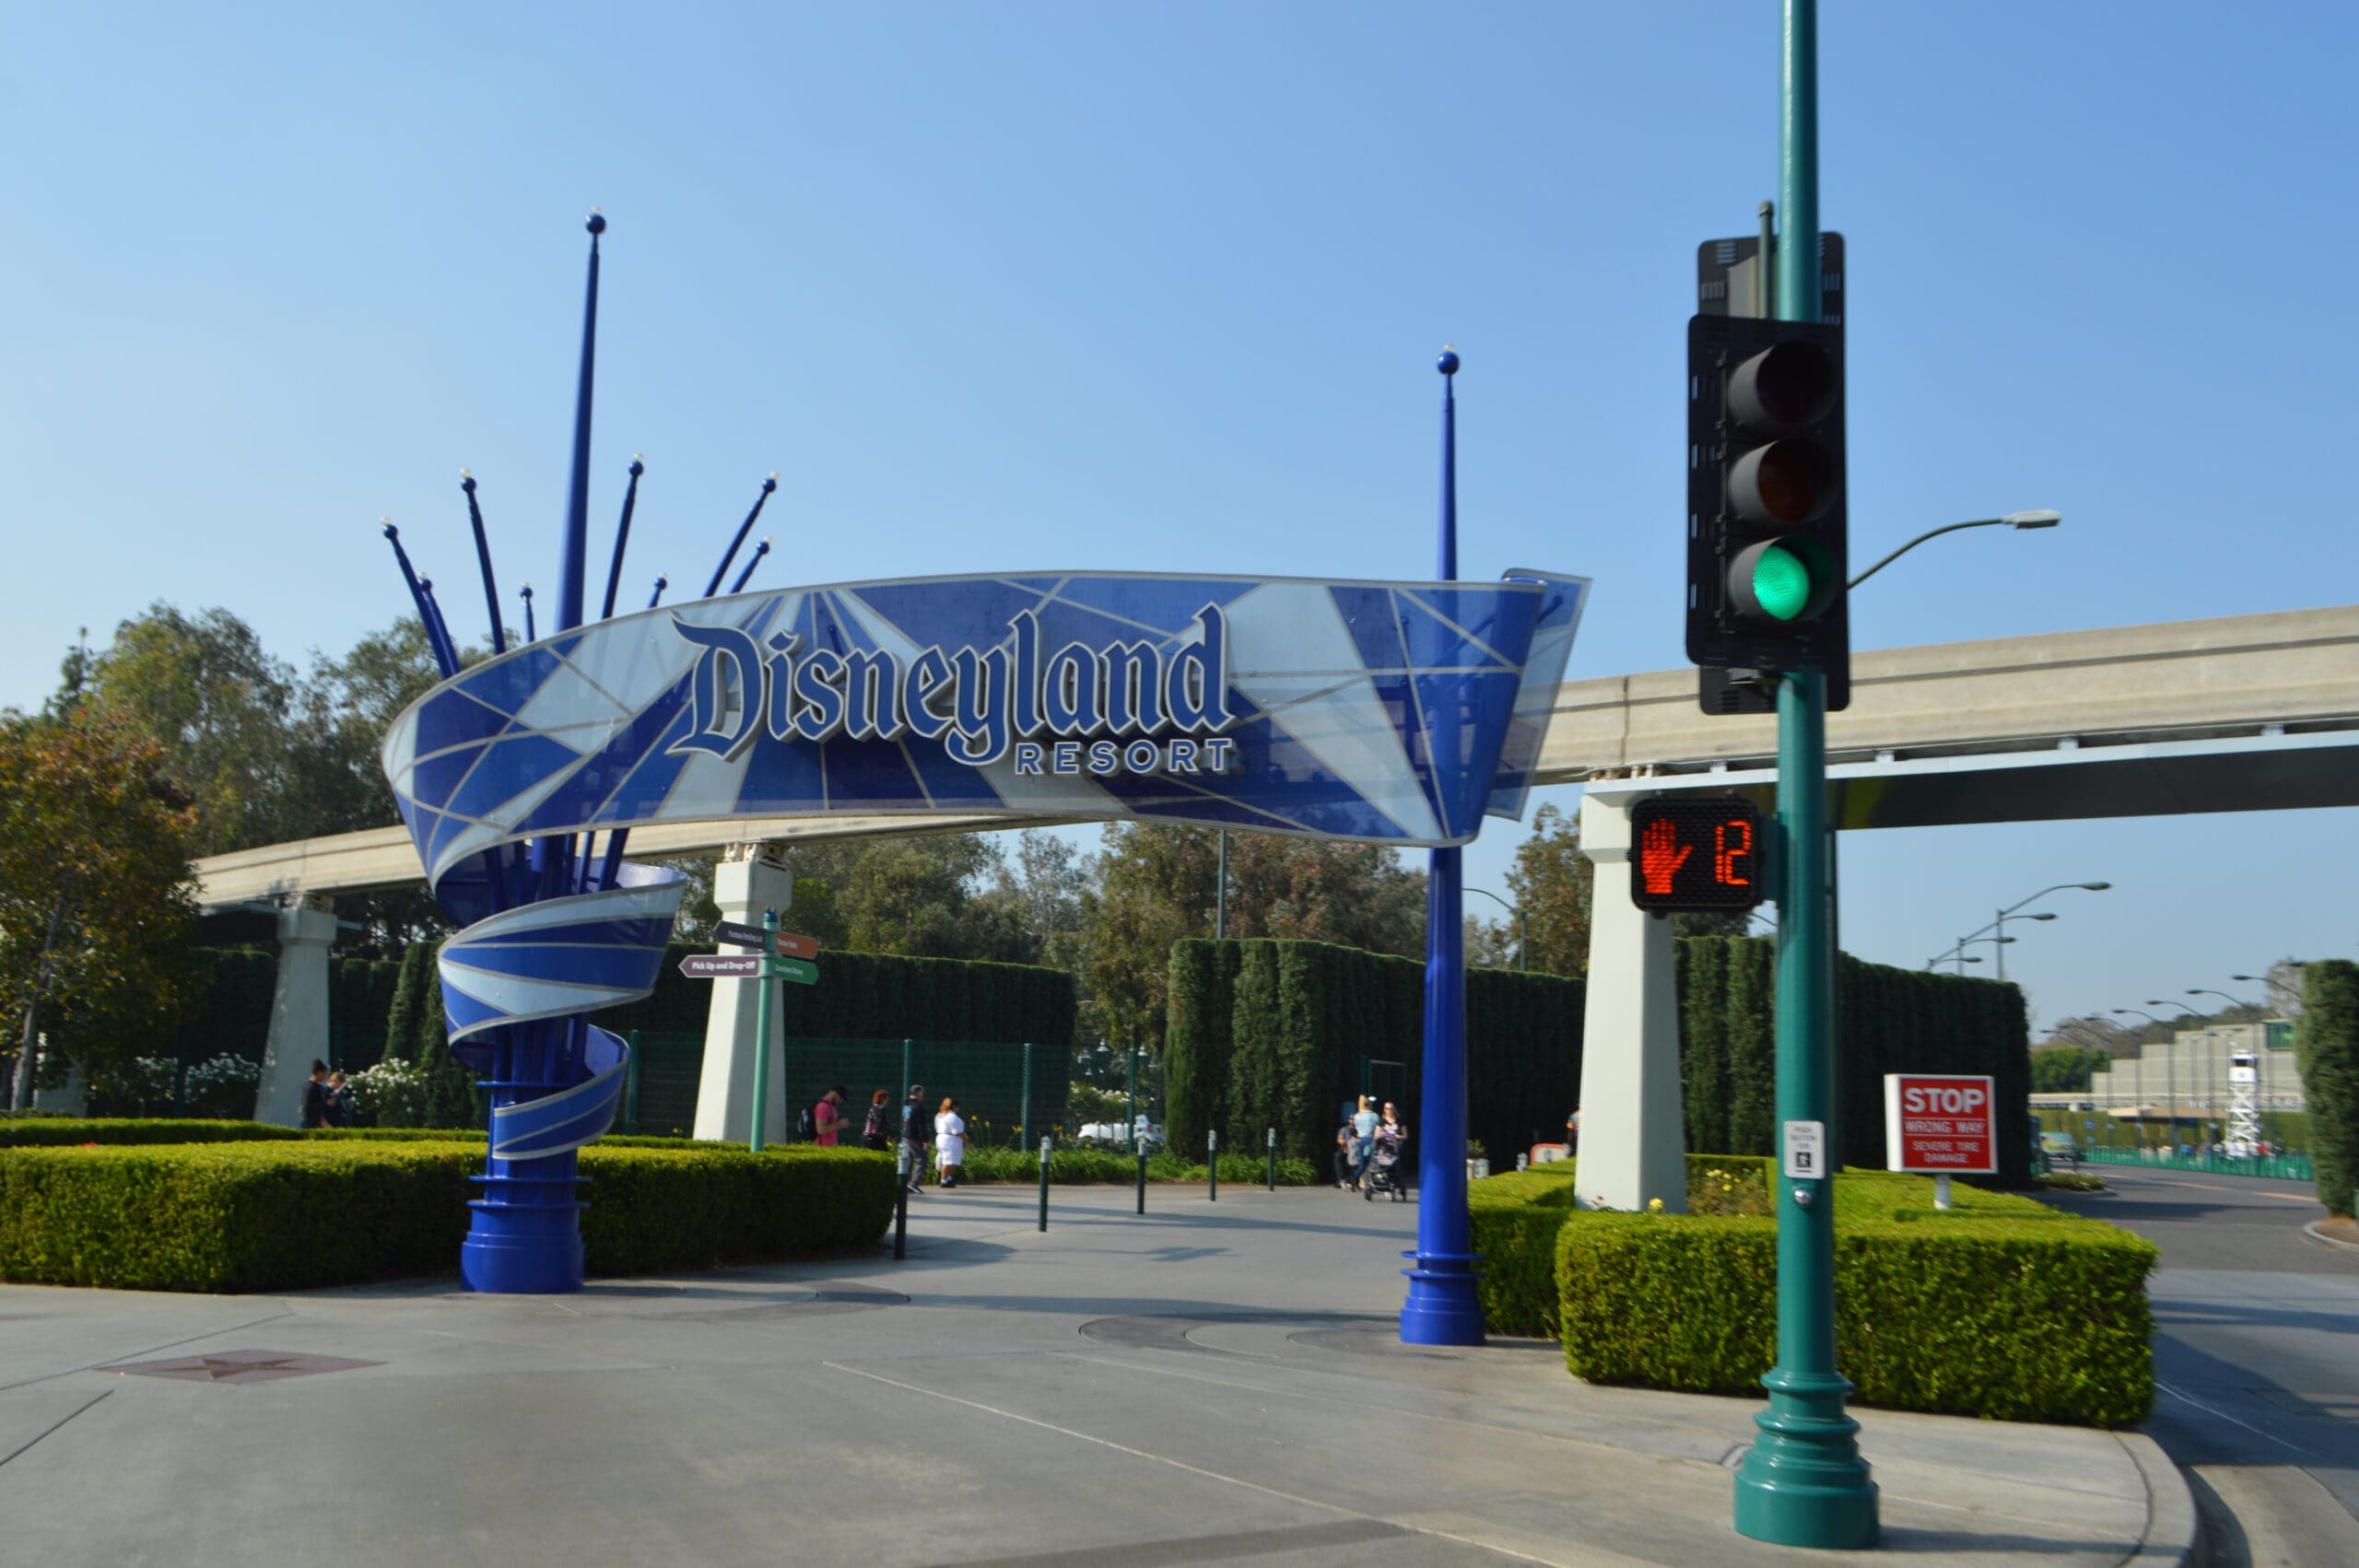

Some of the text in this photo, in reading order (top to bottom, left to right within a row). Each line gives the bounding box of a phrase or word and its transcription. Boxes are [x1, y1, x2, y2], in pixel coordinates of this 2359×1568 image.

[664, 601, 1236, 766] Disneyland
[1015, 738, 1234, 776] RESORT
[1715, 819, 1752, 886] 12
[716, 961, 728, 970] and
[1904, 1086, 1986, 1115] STOP
[1905, 1119, 1986, 1134] WRONG WAY
[1912, 1141, 1980, 1153] SEVERE TIRE
[1923, 1152, 1969, 1164] DAMAGE
